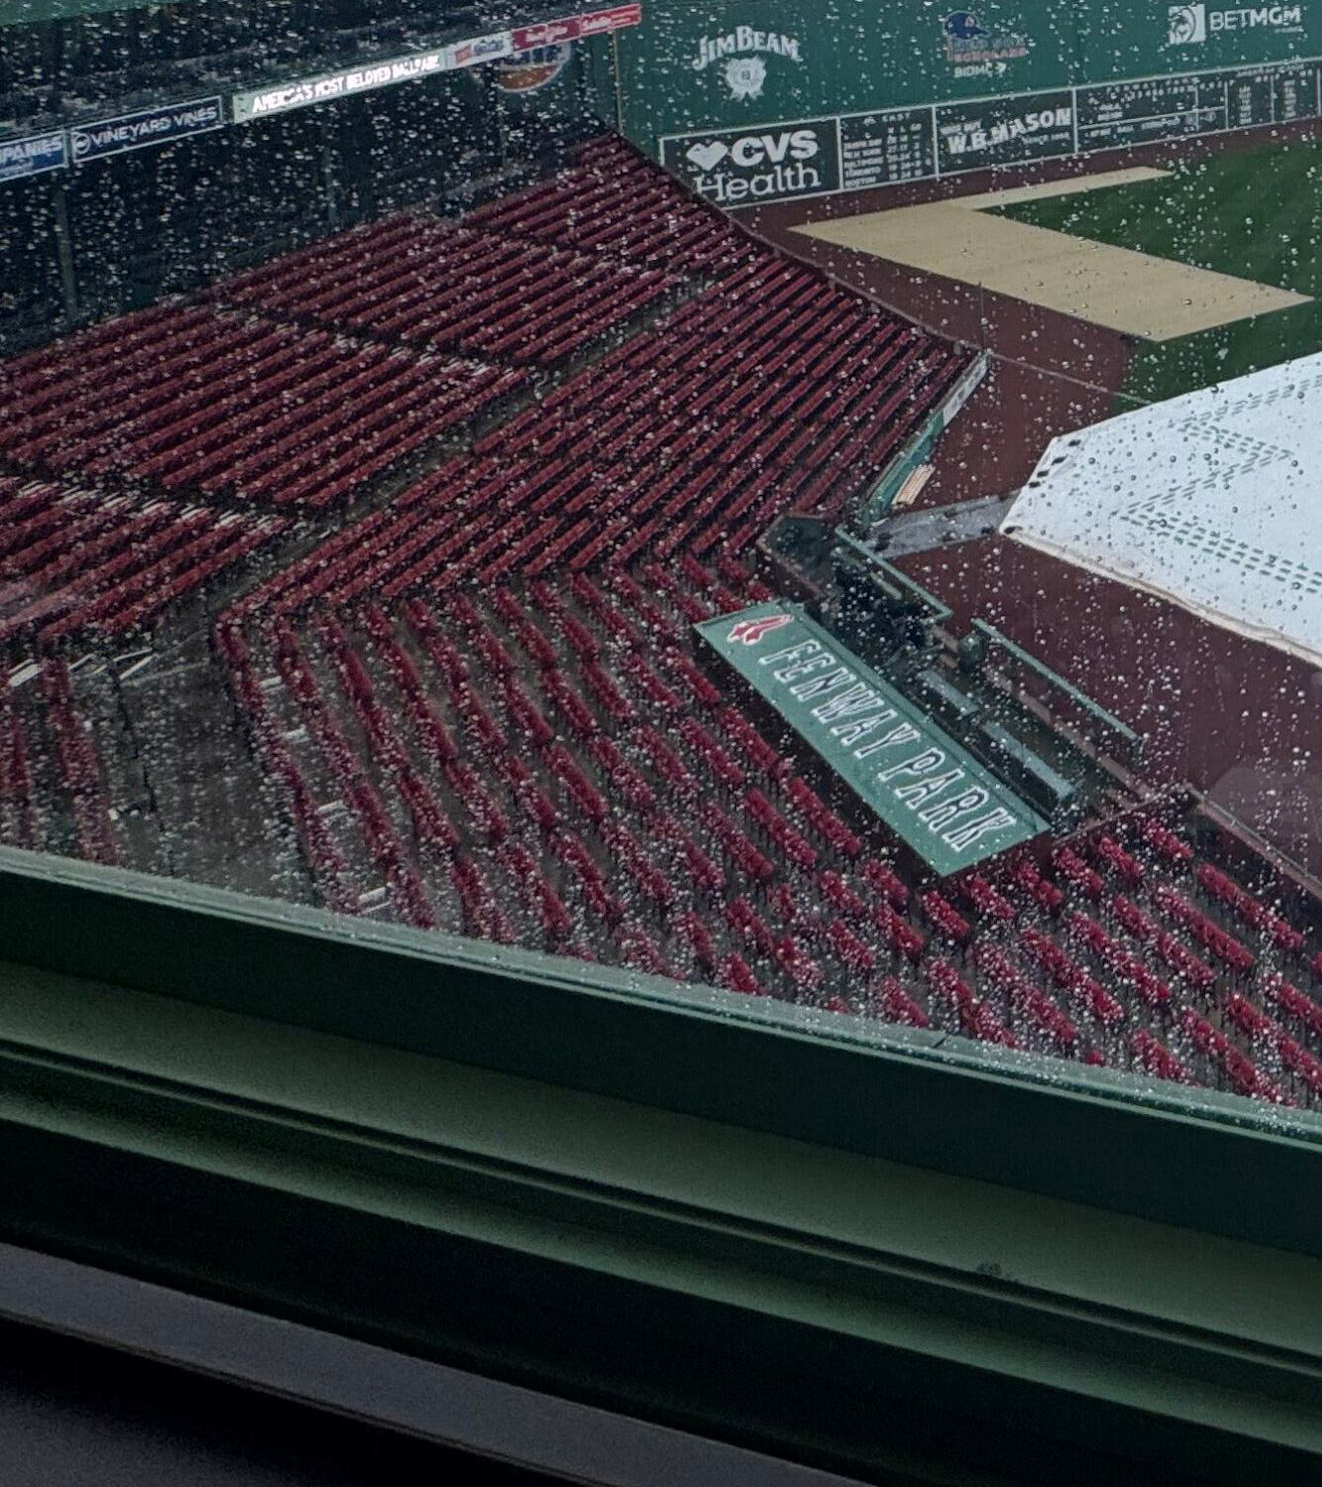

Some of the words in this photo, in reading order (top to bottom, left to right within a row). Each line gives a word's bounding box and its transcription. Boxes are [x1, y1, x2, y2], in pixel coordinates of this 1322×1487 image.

[1209, 6, 1301, 32] BETMGM
[691, 34, 737, 71] JIM
[736, 25, 804, 62] BEAM
[252, 85, 312, 113] AMERICA'S
[313, 78, 345, 99] MOST
[346, 66, 392, 92] BELOVED
[90, 117, 172, 147] VINEYARD
[172, 106, 218, 127] VINES
[731, 129, 818, 168] CVS
[695, 162, 822, 202] Health
[758, 639, 921, 759] FENWAY
[877, 746, 1018, 853] PARK
